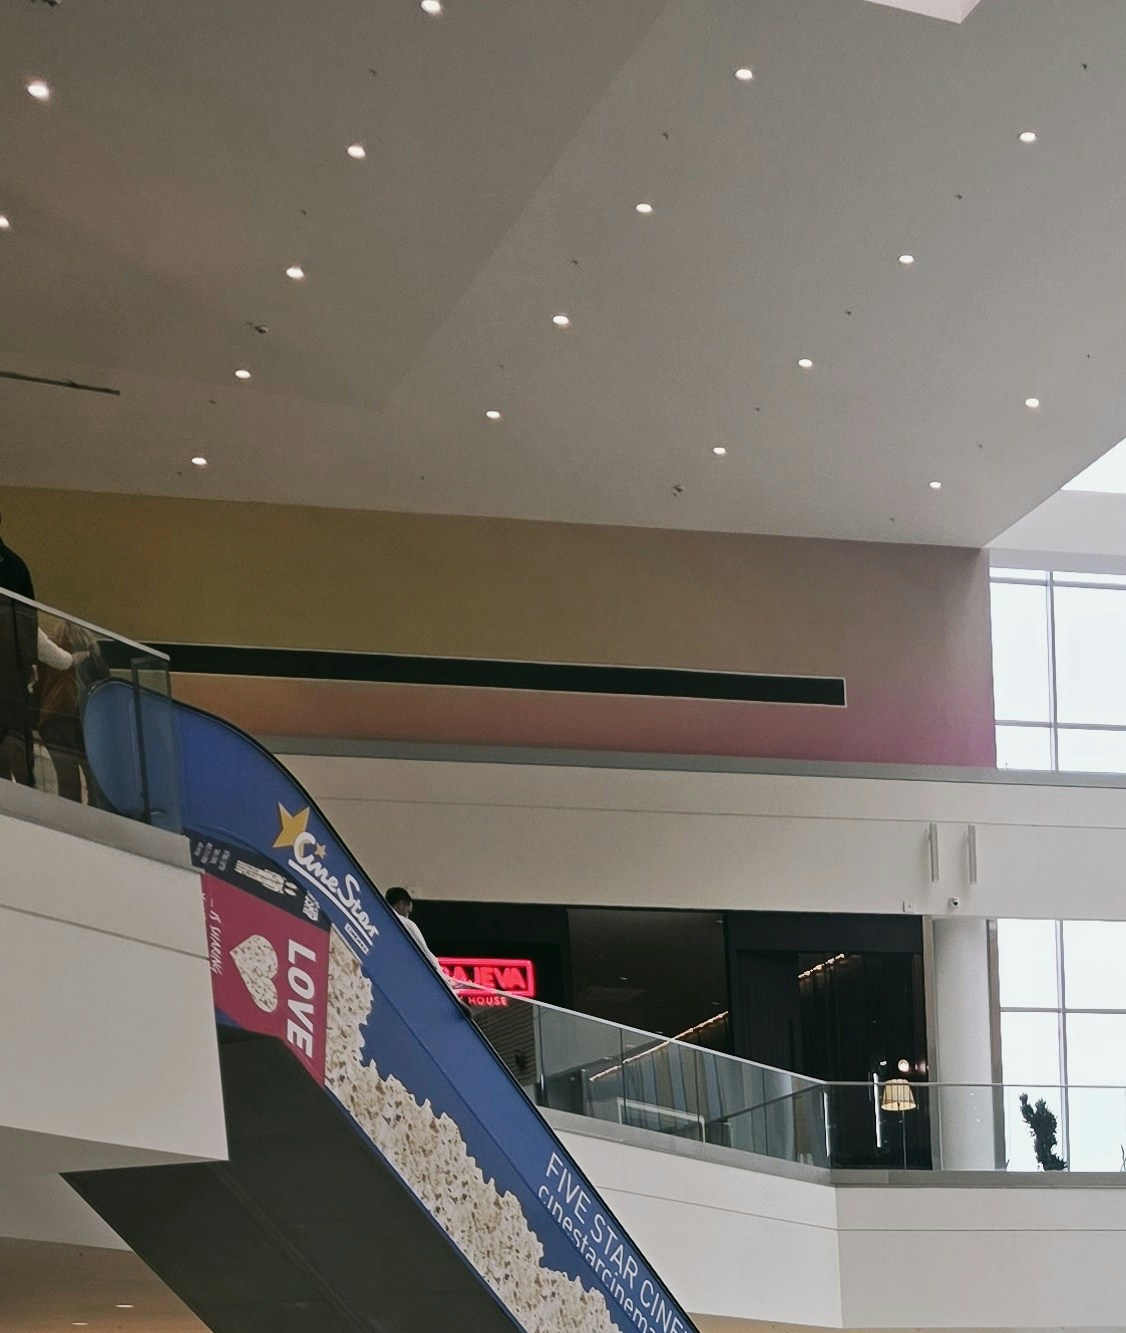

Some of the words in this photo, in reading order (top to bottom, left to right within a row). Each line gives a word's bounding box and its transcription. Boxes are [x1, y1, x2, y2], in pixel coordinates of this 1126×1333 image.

[293, 831, 380, 937] CineStar
[287, 939, 317, 1059] LOVE
[469, 996, 508, 1007] HOUSE
[546, 1152, 591, 1224] FIVE
[590, 1213, 638, 1288] STAR
